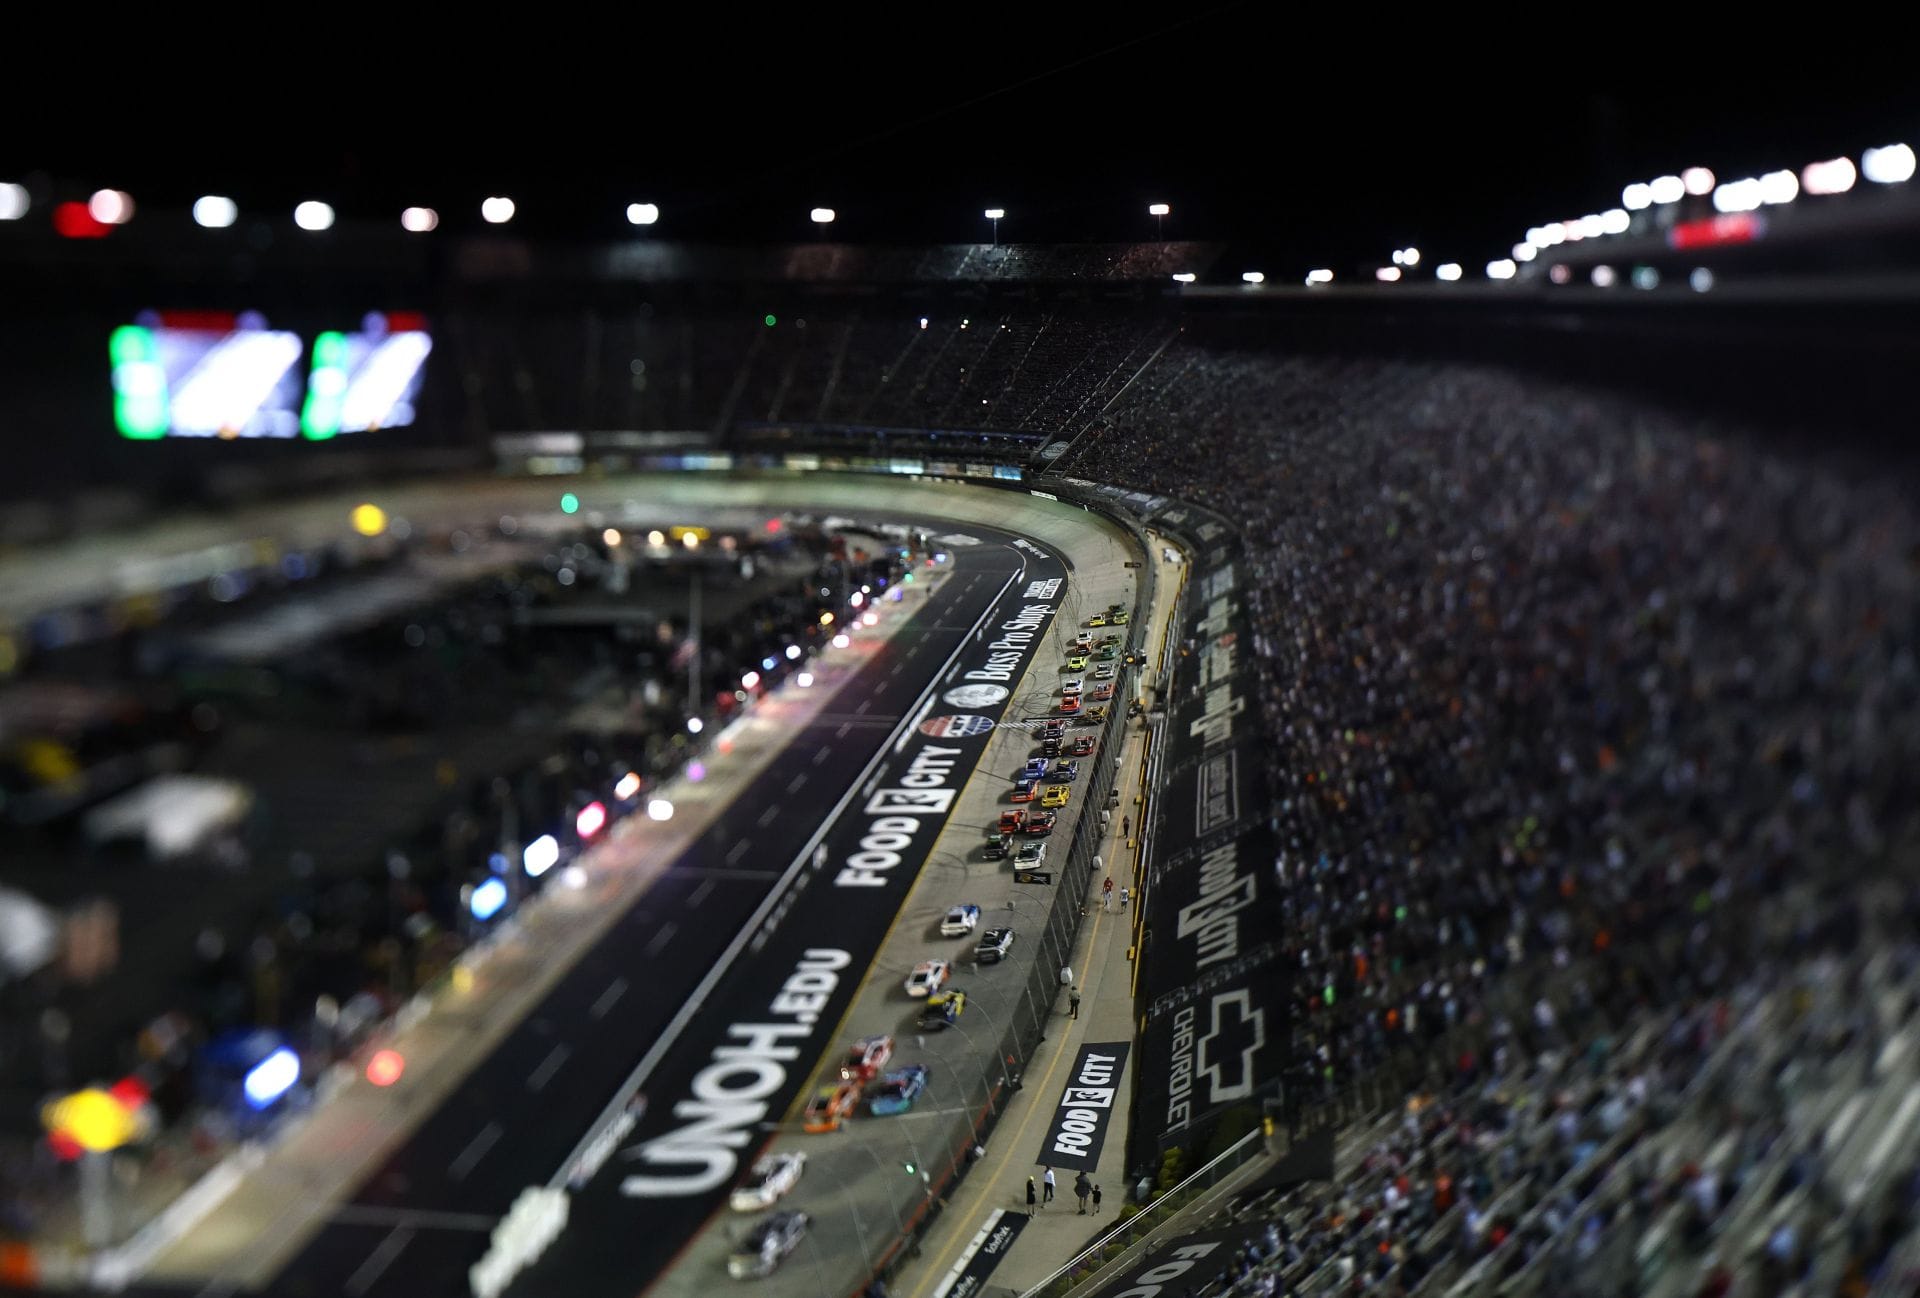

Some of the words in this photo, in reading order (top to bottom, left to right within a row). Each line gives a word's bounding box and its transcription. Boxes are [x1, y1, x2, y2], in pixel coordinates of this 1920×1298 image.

[987, 632, 1034, 650] Pro
[1001, 604, 1056, 631] Shops
[965, 651, 1023, 680] Bass
[834, 816, 920, 887] FOOD
[900, 744, 962, 788] CITY
[1199, 842, 1238, 896] FOOD
[1196, 915, 1238, 967] CITY
[620, 948, 852, 1197] UNOH.EDU
[1166, 1005, 1195, 1134] CHEVROLET
[1053, 1108, 1098, 1157] FOOD
[1078, 1053, 1117, 1085] CITY
